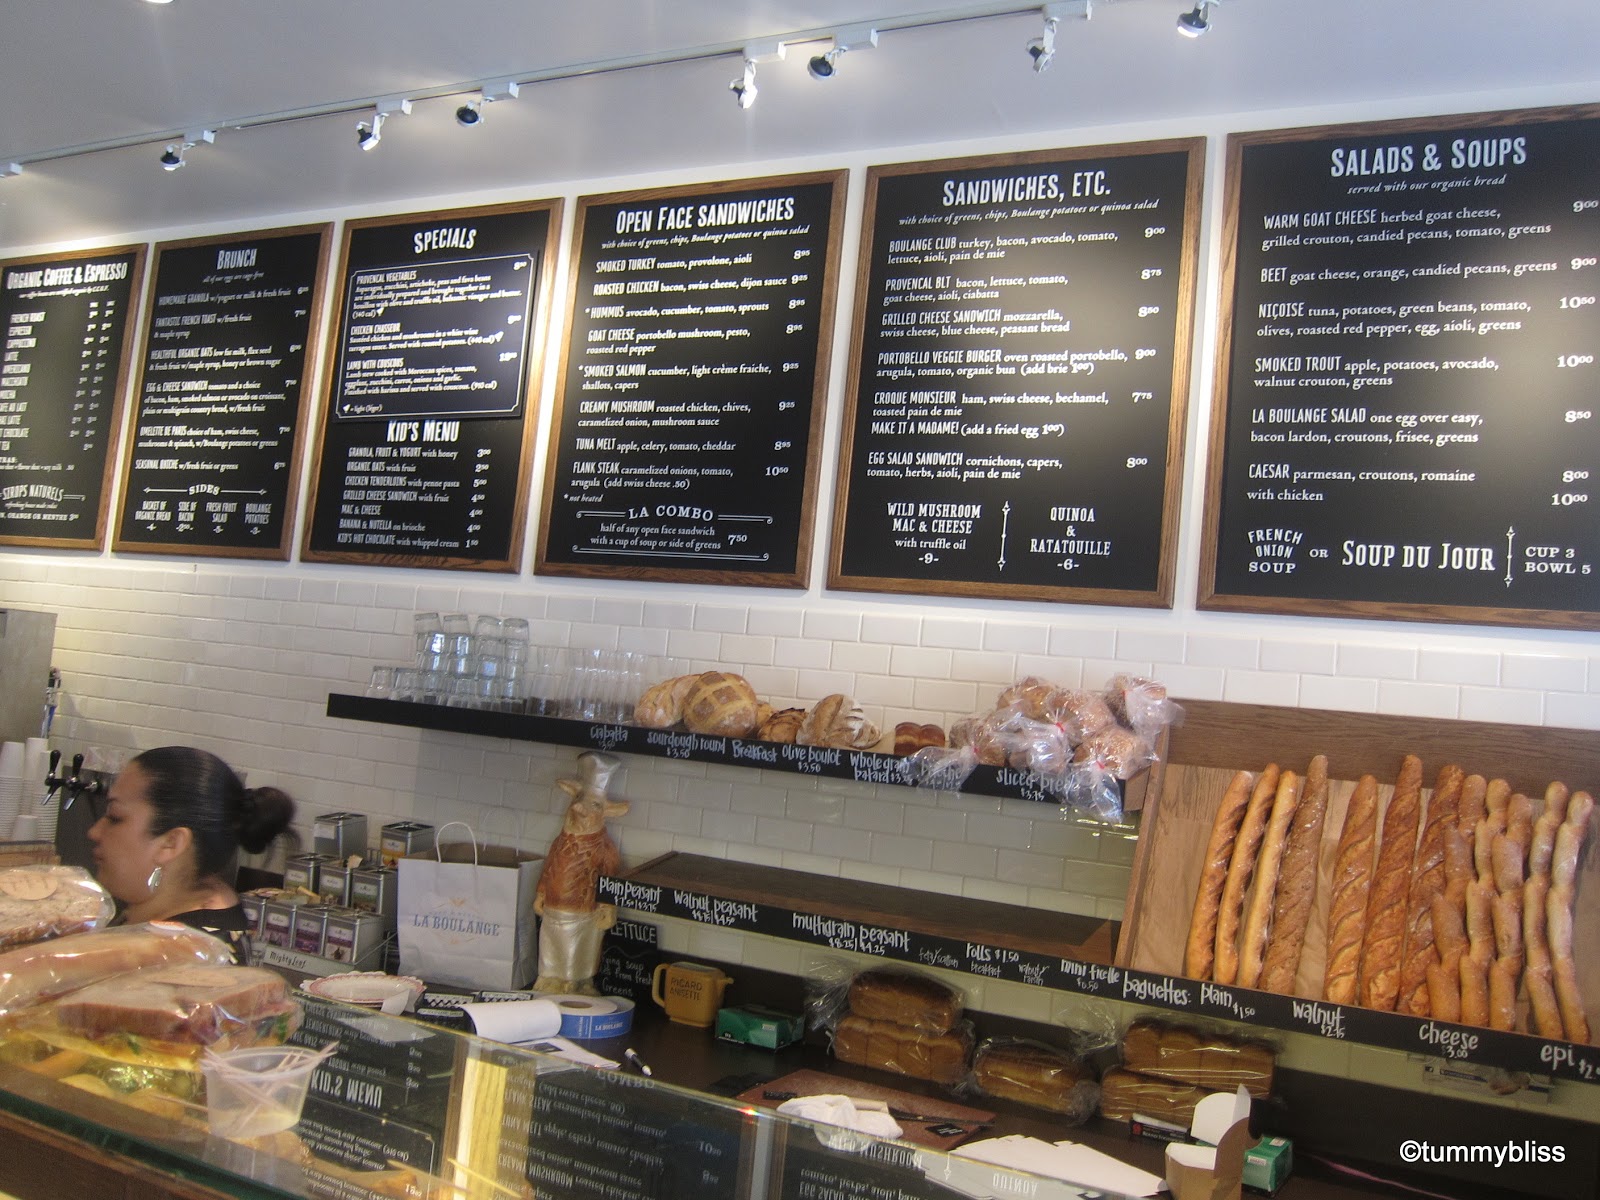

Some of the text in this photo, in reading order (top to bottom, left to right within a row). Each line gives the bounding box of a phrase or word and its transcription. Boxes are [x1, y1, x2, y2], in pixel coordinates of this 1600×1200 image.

[1331, 137, 1527, 177] SALADS & SOUPS
[943, 171, 1111, 206] SANDWICHES, ETC.
[1348, 174, 1507, 194] served with our organic bread
[616, 198, 795, 234] OPEN FACE SANDWICHES
[1263, 207, 1501, 229] WARM GOAT CHEESE herbed goat cheese,
[414, 228, 477, 253] SPECIALS
[889, 230, 1118, 253] BOULANGE CLUB turkey, bacon, avocado, tomato,
[217, 249, 257, 270] BRUNCH
[596, 254, 752, 273] SMOKED TURKEY tomato, provolone, aioli
[8, 262, 128, 289] ORGANIC COFFEE & ESPRESSO
[1260, 260, 1557, 285] BEET goat cheese, orange, candied pecans, greens
[1255, 356, 1499, 373] SMOKED TROUT apple, potatoes, avocado,
[1252, 408, 1483, 426] LA BOULANGE SALAD one egg over easy,
[387, 420, 461, 442] KID'S MENU
[1249, 464, 1475, 483] CAESAR parmesan, croutons, romaine
[189, 484, 220, 495] SIDES
[1247, 489, 1323, 501] with chicken
[629, 506, 713, 522] LA COMBO
[887, 503, 981, 519] WILD MUSHROOM
[1050, 507, 1095, 522] QUINOA
[892, 519, 972, 534] MAC & CHEESE
[1066, 526, 1076, 537] &
[895, 538, 966, 550] with truffle oil
[1248, 528, 1302, 544] FRENCH
[1030, 539, 1111, 556] RATATOUILLE
[1255, 544, 1293, 559] ONION
[1309, 548, 1328, 558] OR
[1342, 540, 1495, 571] SOUP DU JOUR
[1525, 546, 1574, 558] CUP 3
[1248, 562, 1295, 574] SOUP
[1524, 562, 1591, 574] BOWL 5
[700, 737, 727, 753] round
[413, 914, 429, 927] LA
[432, 916, 500, 936] BOULANGE
[611, 921, 657, 943] LETTUCE
[1540, 1045, 1575, 1070] epi
